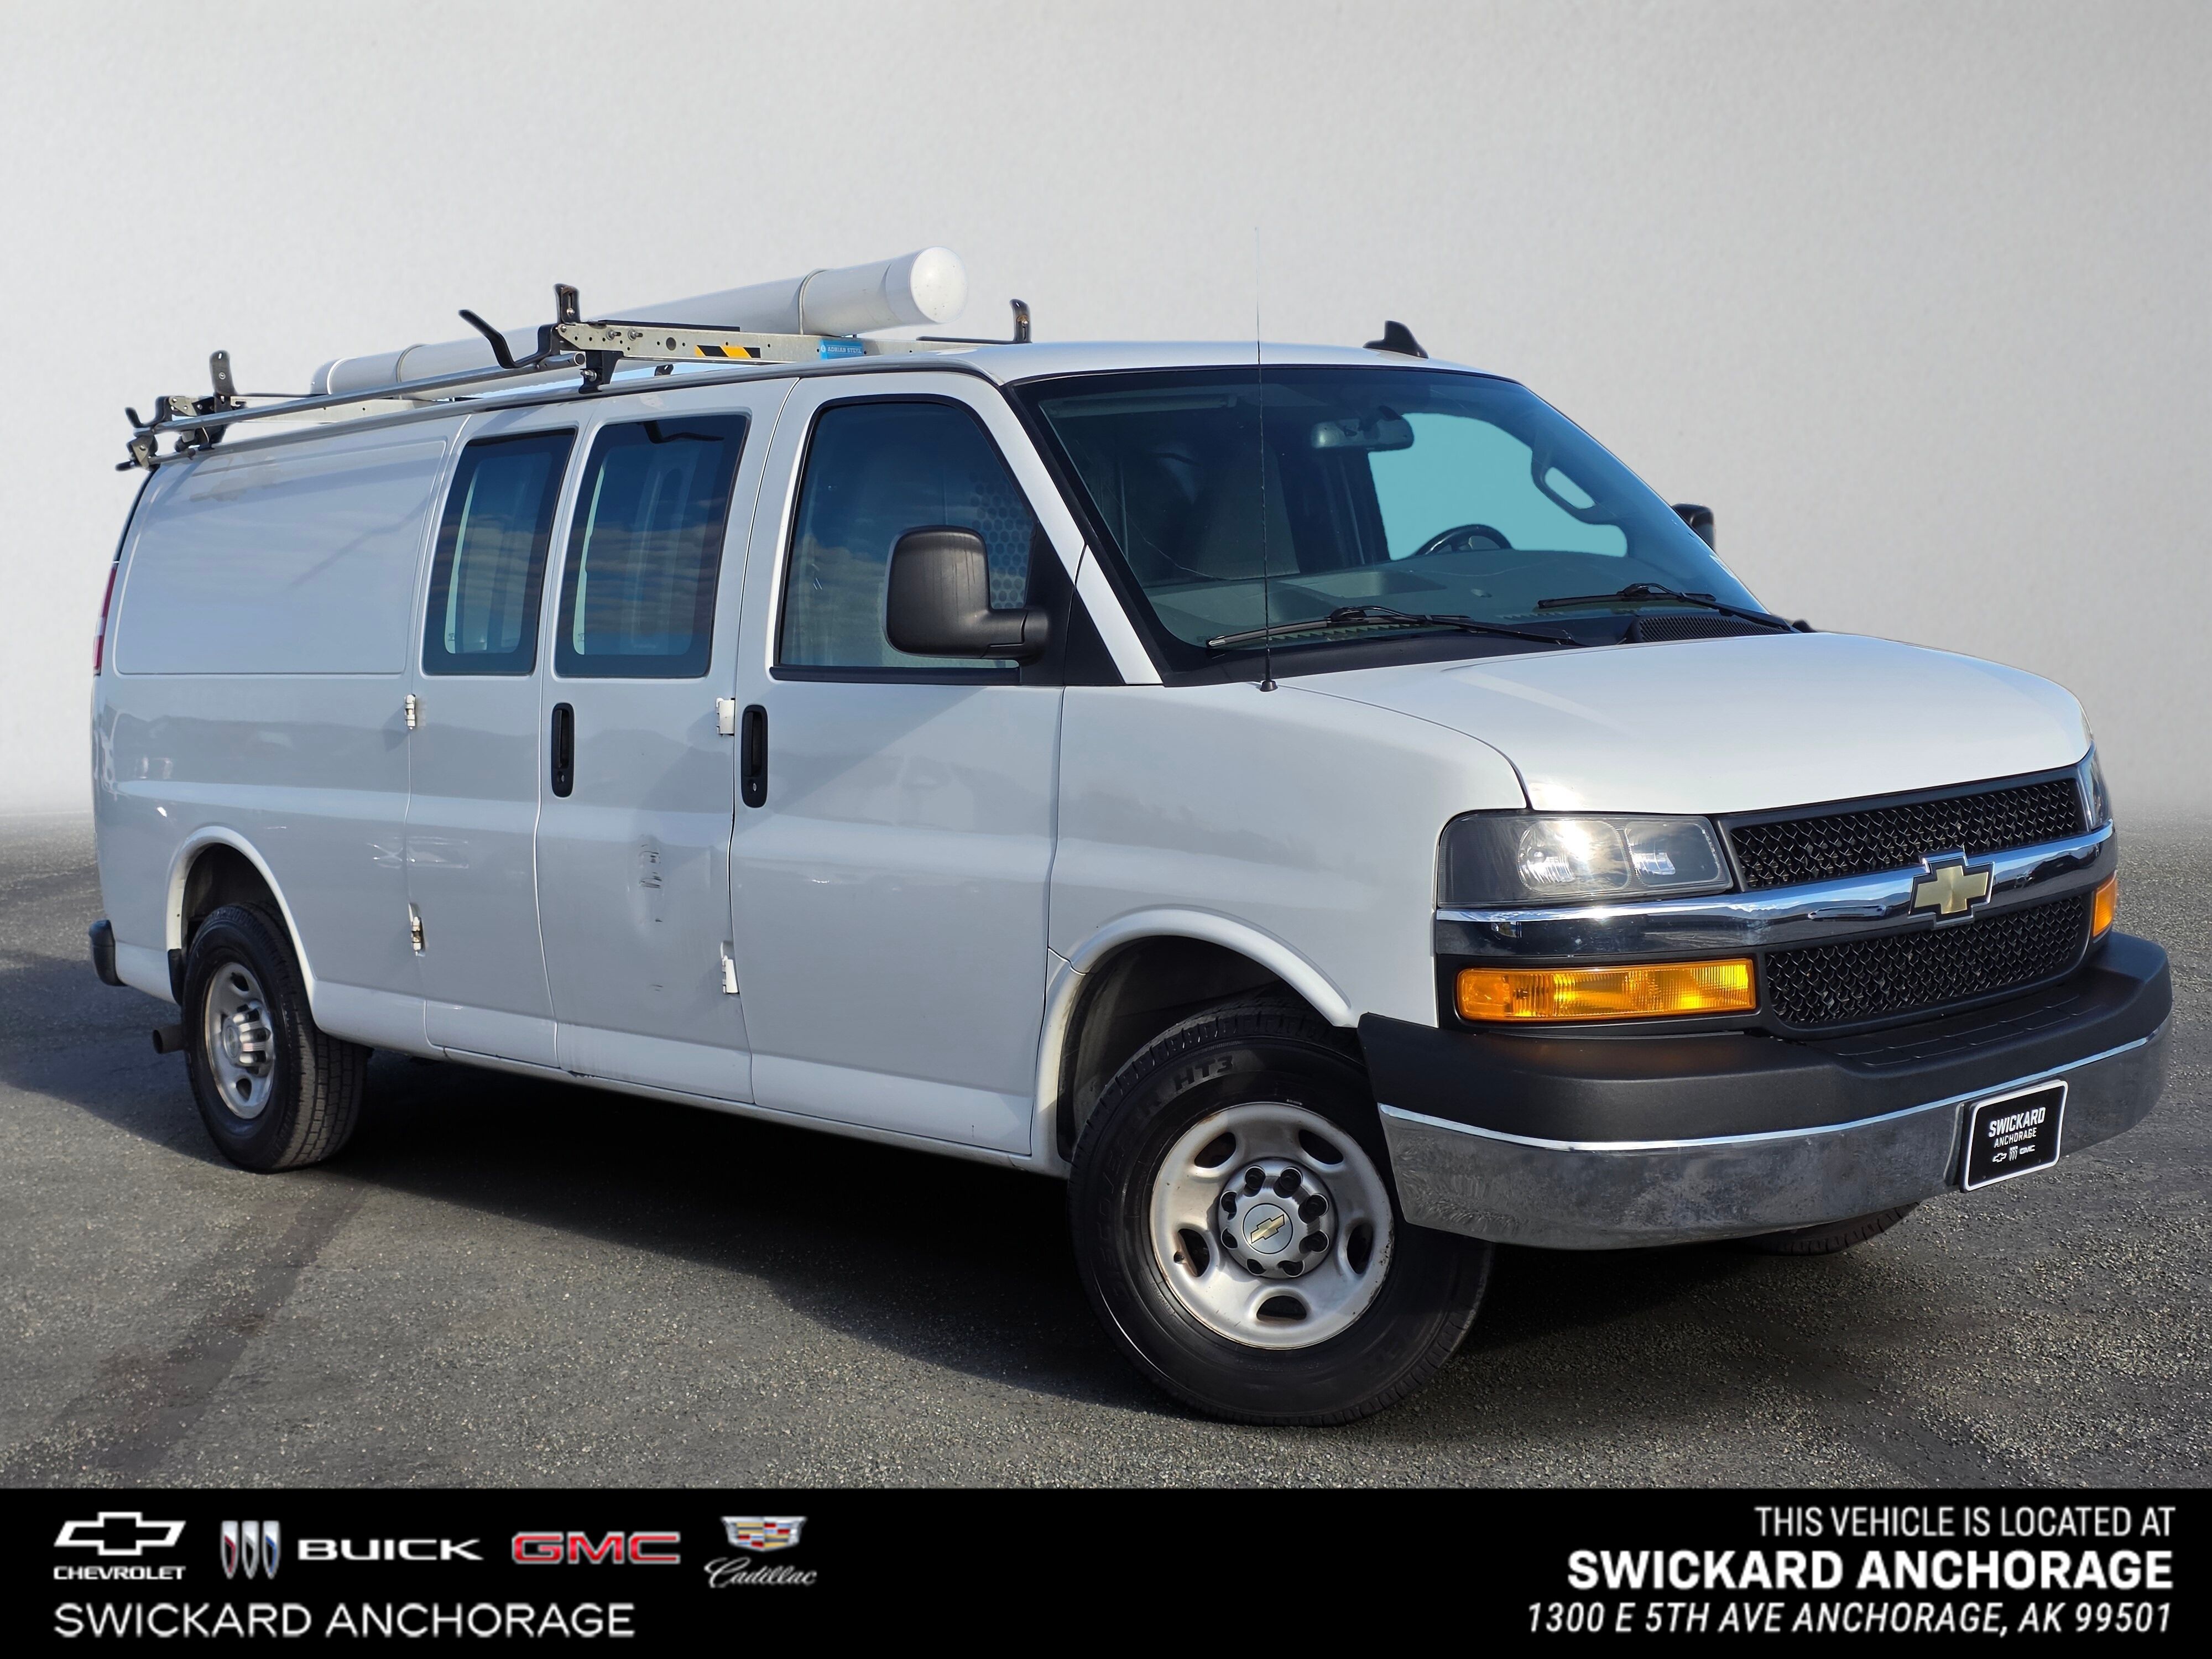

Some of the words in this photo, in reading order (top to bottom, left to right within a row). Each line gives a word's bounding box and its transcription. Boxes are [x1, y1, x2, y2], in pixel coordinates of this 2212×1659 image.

[1173, 1055, 1234, 1092] HT3
[1989, 1107, 2046, 1138] SWICKARD
[1994, 1127, 2037, 1148] ANCHORAGE
